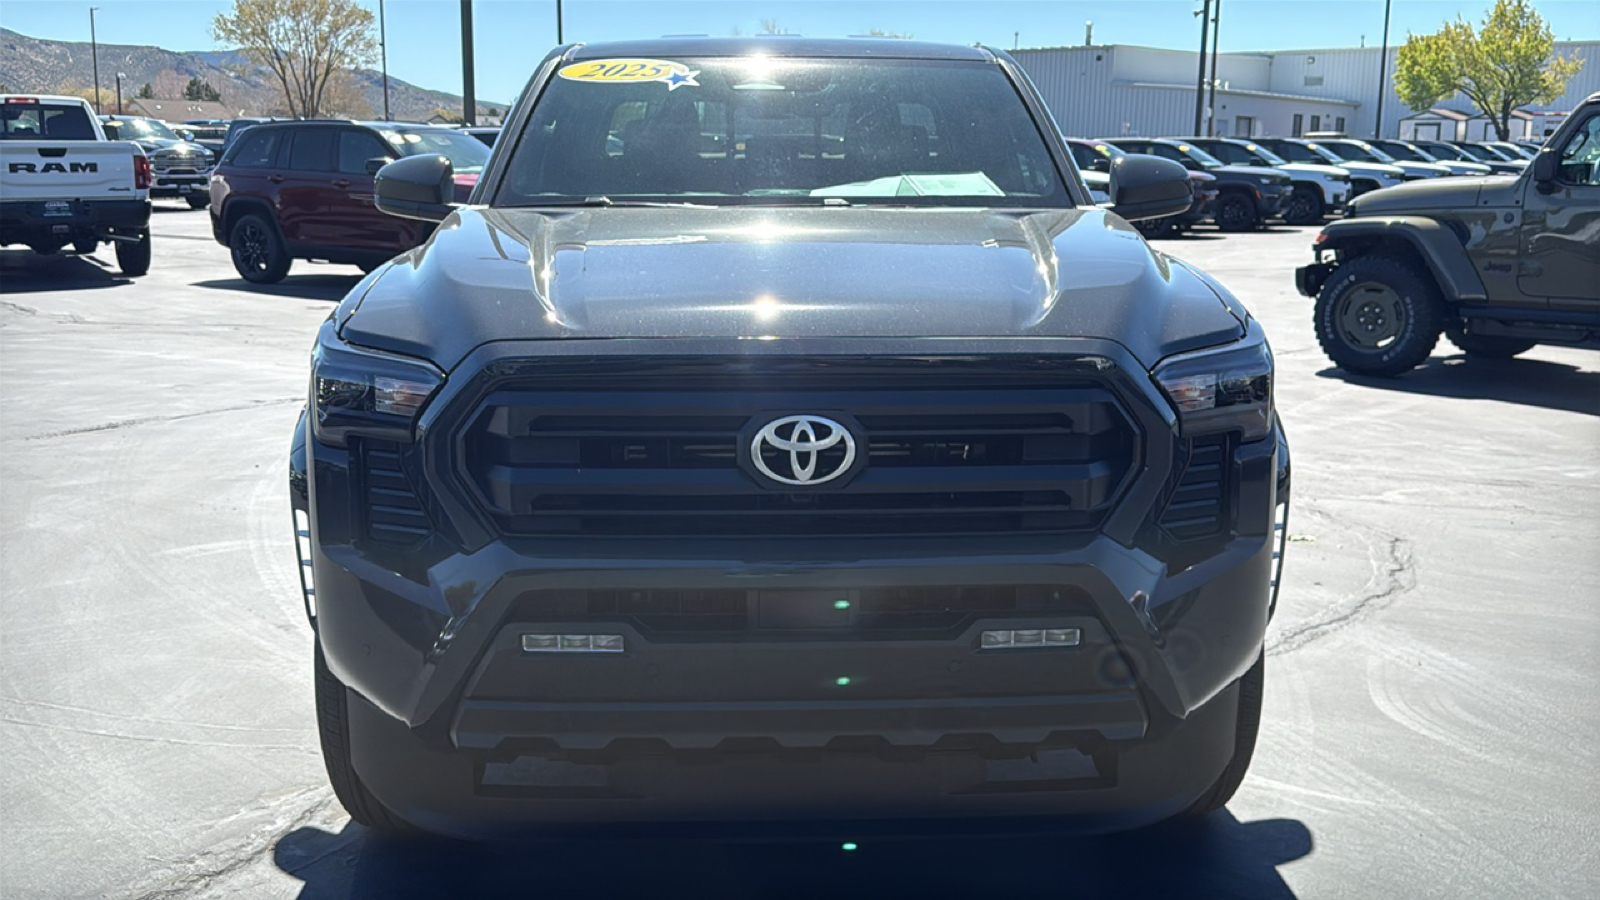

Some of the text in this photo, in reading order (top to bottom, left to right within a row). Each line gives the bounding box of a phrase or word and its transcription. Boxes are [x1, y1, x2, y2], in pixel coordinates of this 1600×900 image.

[579, 64, 668, 77] 2025
[8, 162, 98, 173] RAM
[1484, 261, 1511, 272] Jeep
